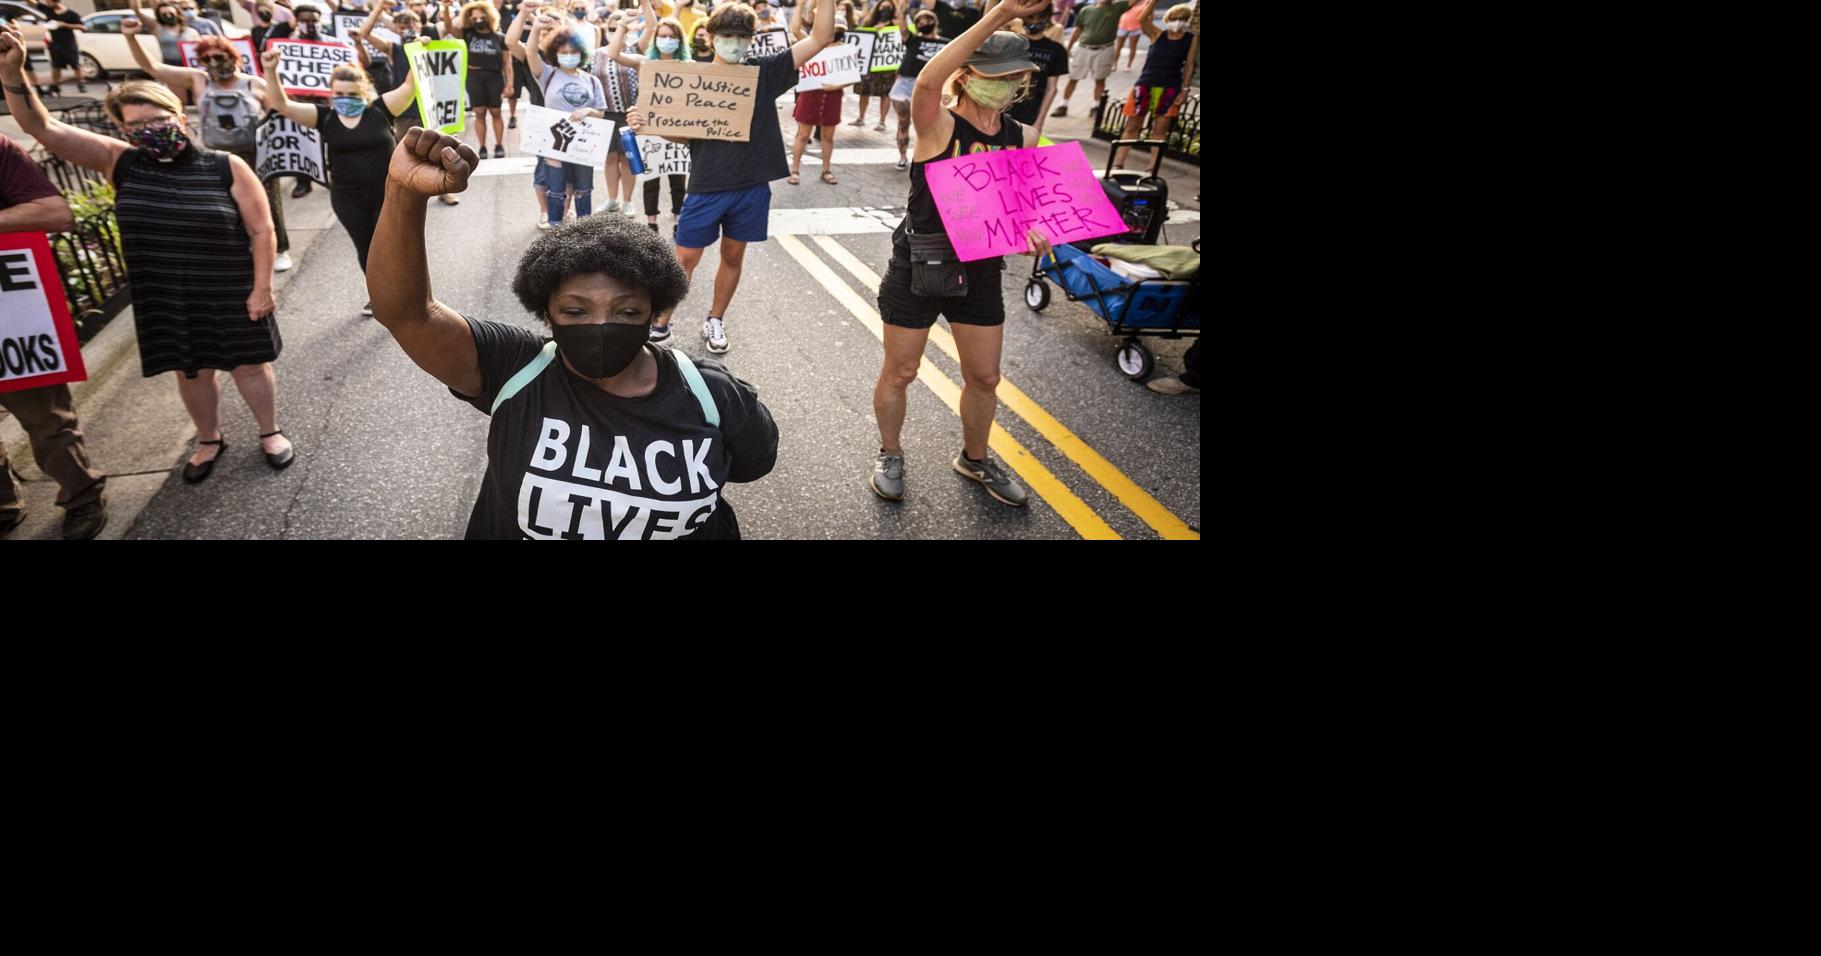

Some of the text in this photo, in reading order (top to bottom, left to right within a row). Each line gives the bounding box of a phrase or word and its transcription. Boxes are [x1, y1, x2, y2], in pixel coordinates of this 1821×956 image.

[279, 44, 352, 62] RELEASE
[690, 75, 751, 97] Justice
[686, 92, 737, 110] Peace
[648, 111, 729, 127] Prosecute the
[706, 127, 743, 137] Police
[289, 152, 320, 179] FLOYD
[665, 150, 690, 160] LIV
[953, 153, 1061, 191] BLACK
[998, 183, 1073, 215] LIVES
[984, 206, 1110, 249] MATTER
[0, 333, 60, 378] OKS
[530, 417, 719, 496] BLACK
